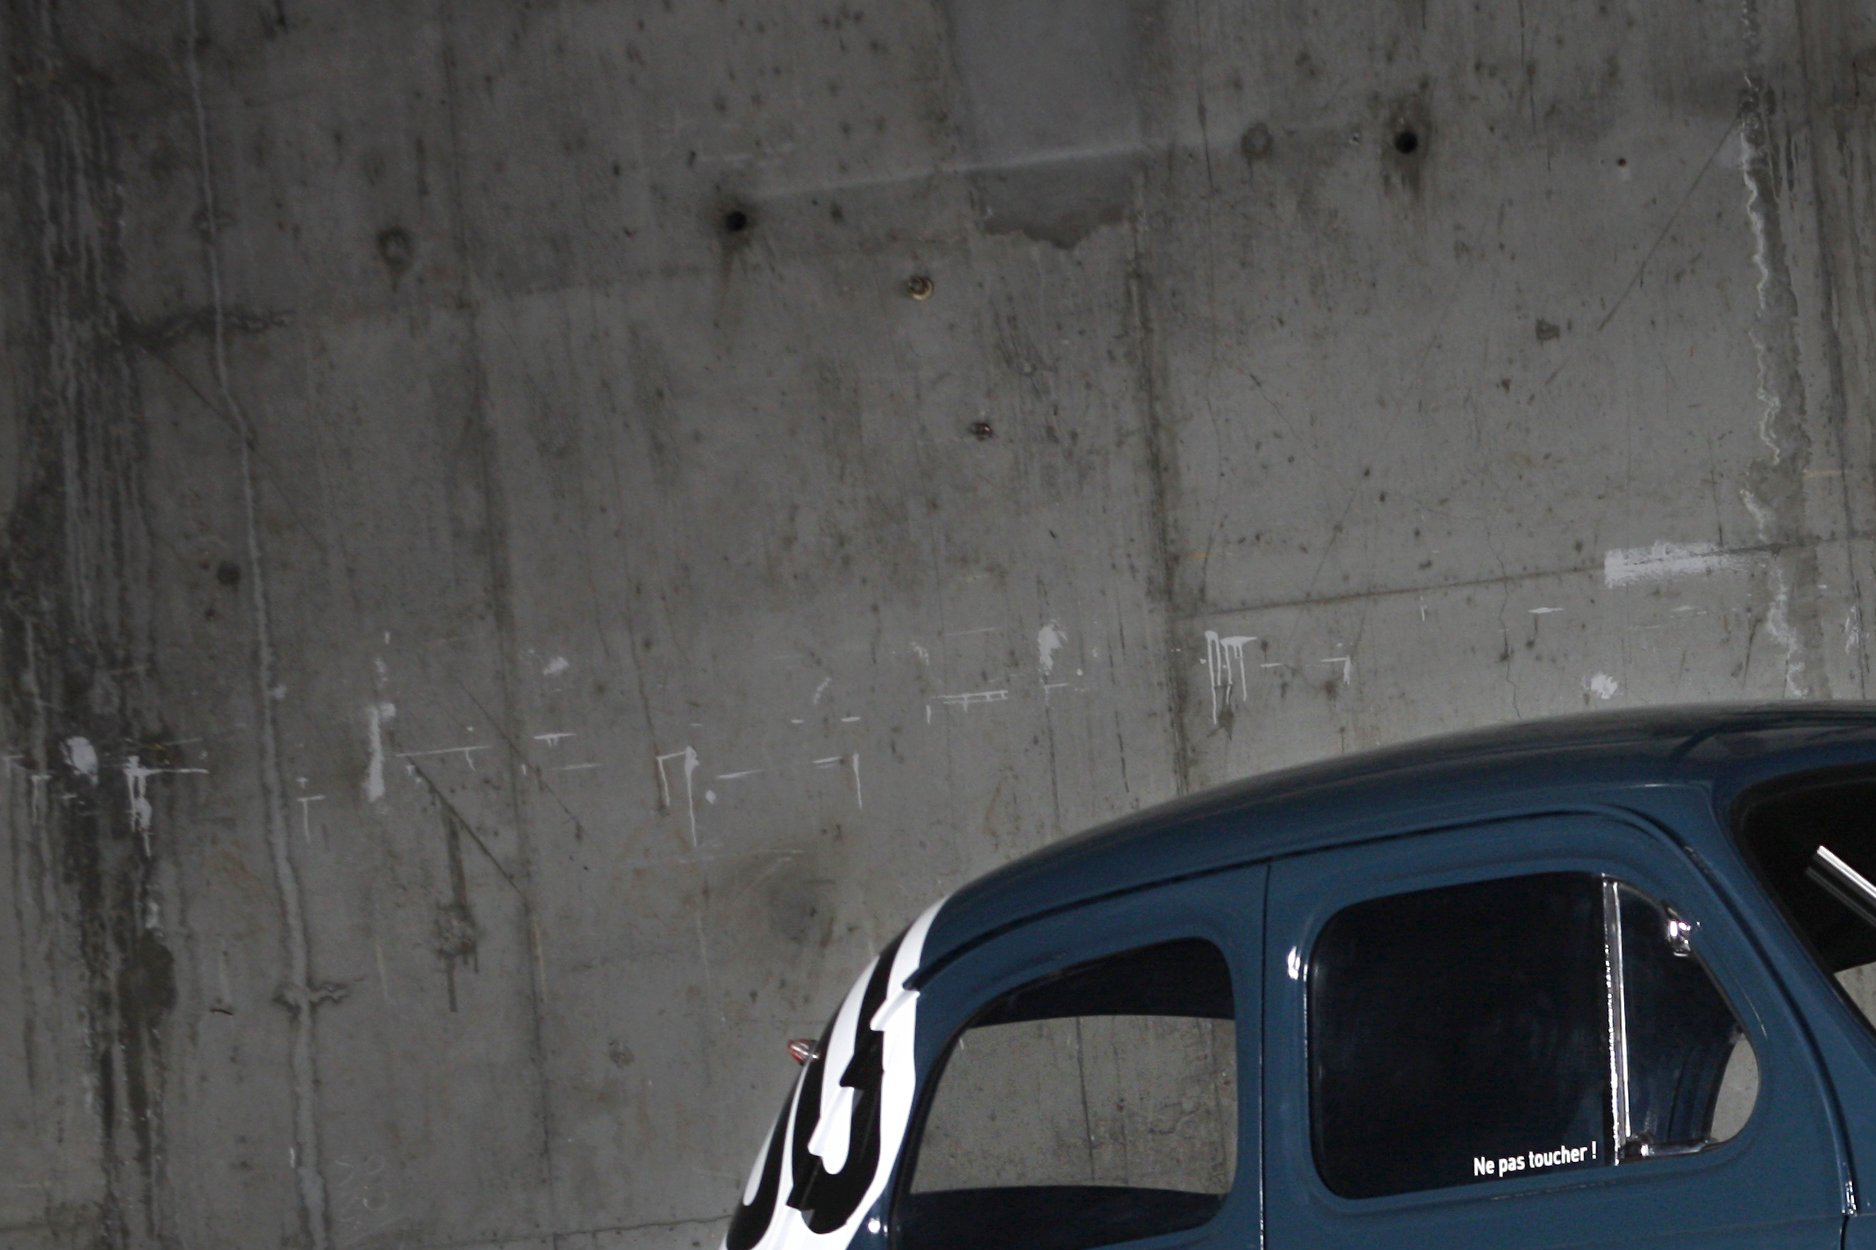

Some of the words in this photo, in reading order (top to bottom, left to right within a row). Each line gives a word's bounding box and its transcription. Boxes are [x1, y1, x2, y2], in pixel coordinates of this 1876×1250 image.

[1474, 1157, 1495, 1176] Ne
[1499, 1156, 1526, 1177] pas
[1529, 1145, 1588, 1169] toucher
